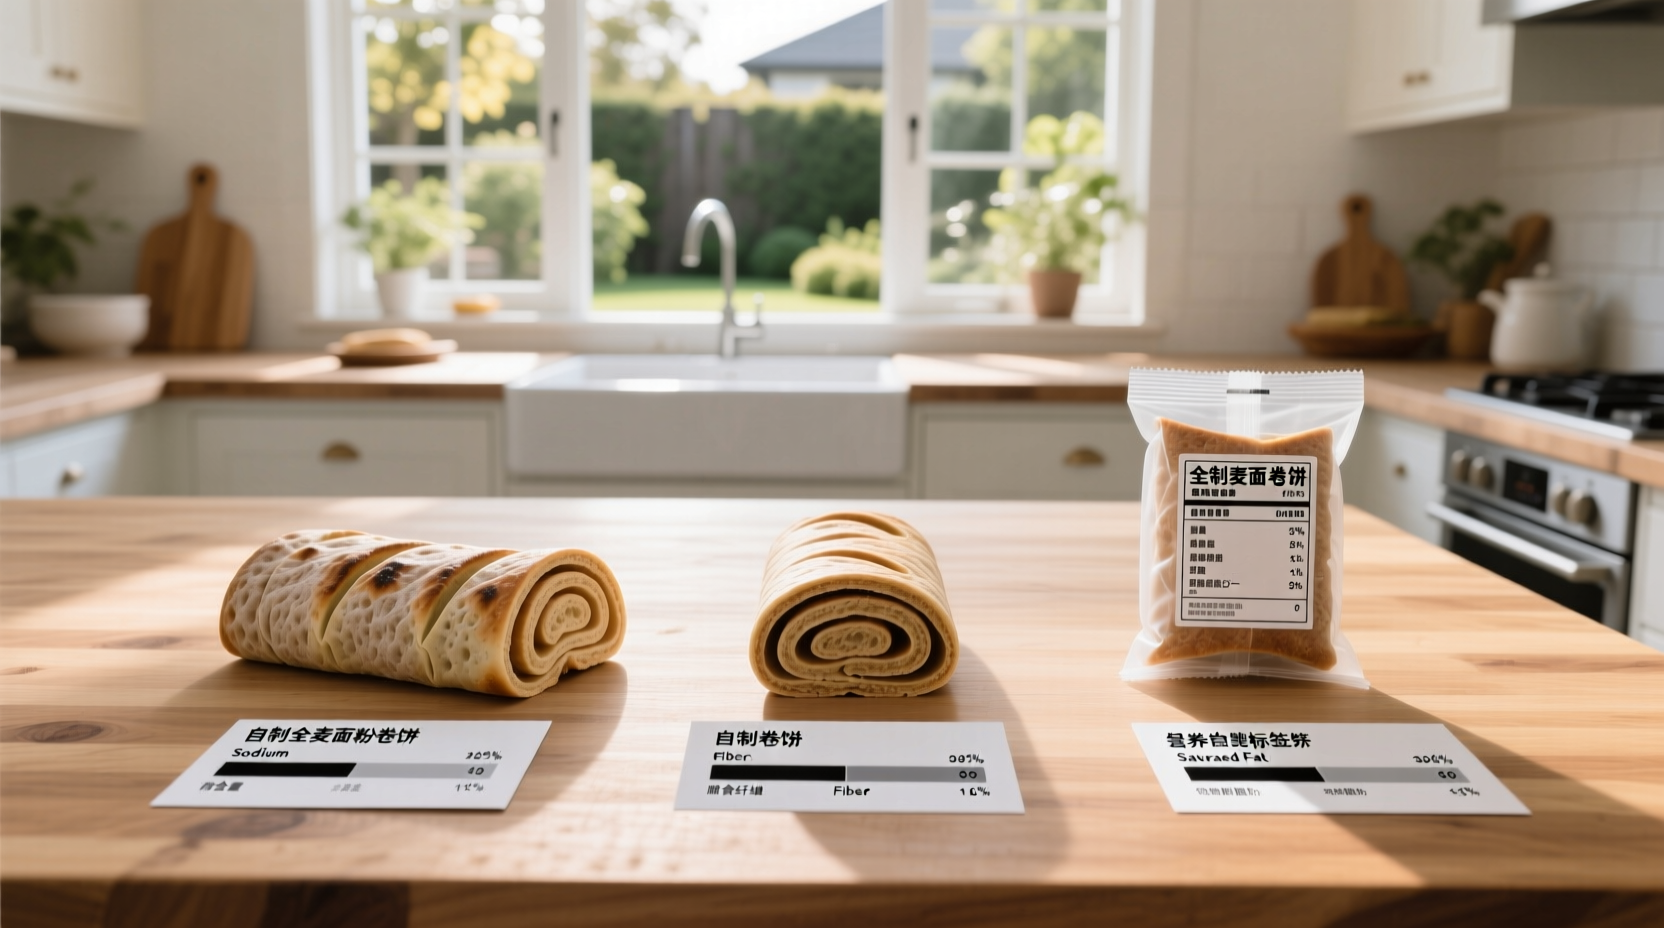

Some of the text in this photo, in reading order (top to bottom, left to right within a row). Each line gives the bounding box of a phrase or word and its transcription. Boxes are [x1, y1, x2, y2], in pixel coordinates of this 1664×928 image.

[1190, 465, 1307, 487] 全制麦面卷饼
[245, 726, 420, 744] 自制全麦面粉卷饼
[716, 730, 803, 748] 自制卷饼
[232, 748, 289, 758] Sodium
[834, 785, 870, 796] Fiber
